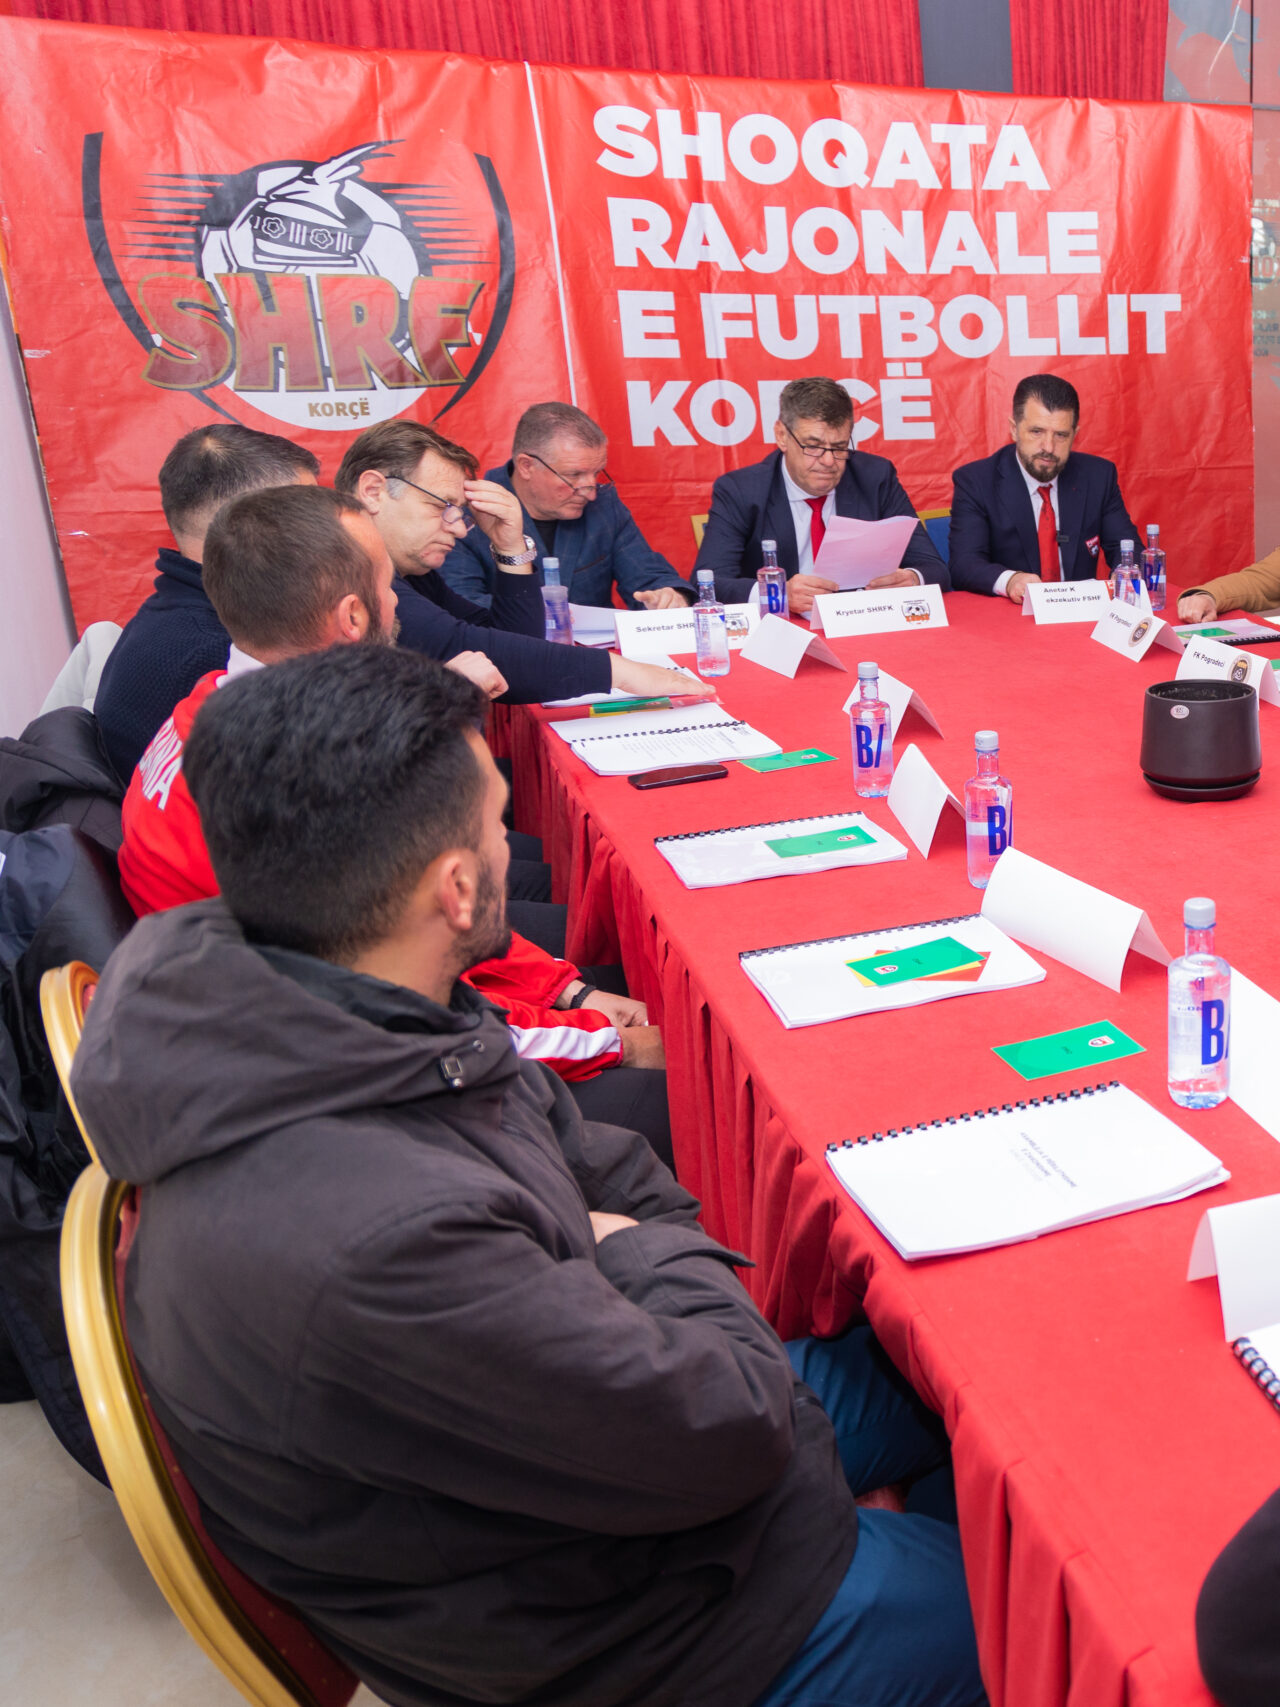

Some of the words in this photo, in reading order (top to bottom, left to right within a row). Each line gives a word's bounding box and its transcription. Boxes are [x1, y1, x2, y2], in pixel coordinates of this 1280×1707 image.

[593, 105, 1050, 191] SHOQATA
[607, 197, 1101, 275] RAJONALE
[138, 272, 486, 391] SHRF
[617, 290, 681, 358] E
[700, 293, 1181, 360] FUTBOLLIT
[308, 397, 370, 420] KORÇË
[635, 624, 675, 633] Sekretar
[836, 608, 865, 618] Kryetar
[866, 605, 894, 614] SHRFK
[1192, 651, 1201, 660] FK
[1200, 653, 1226, 669] Pogradeci
